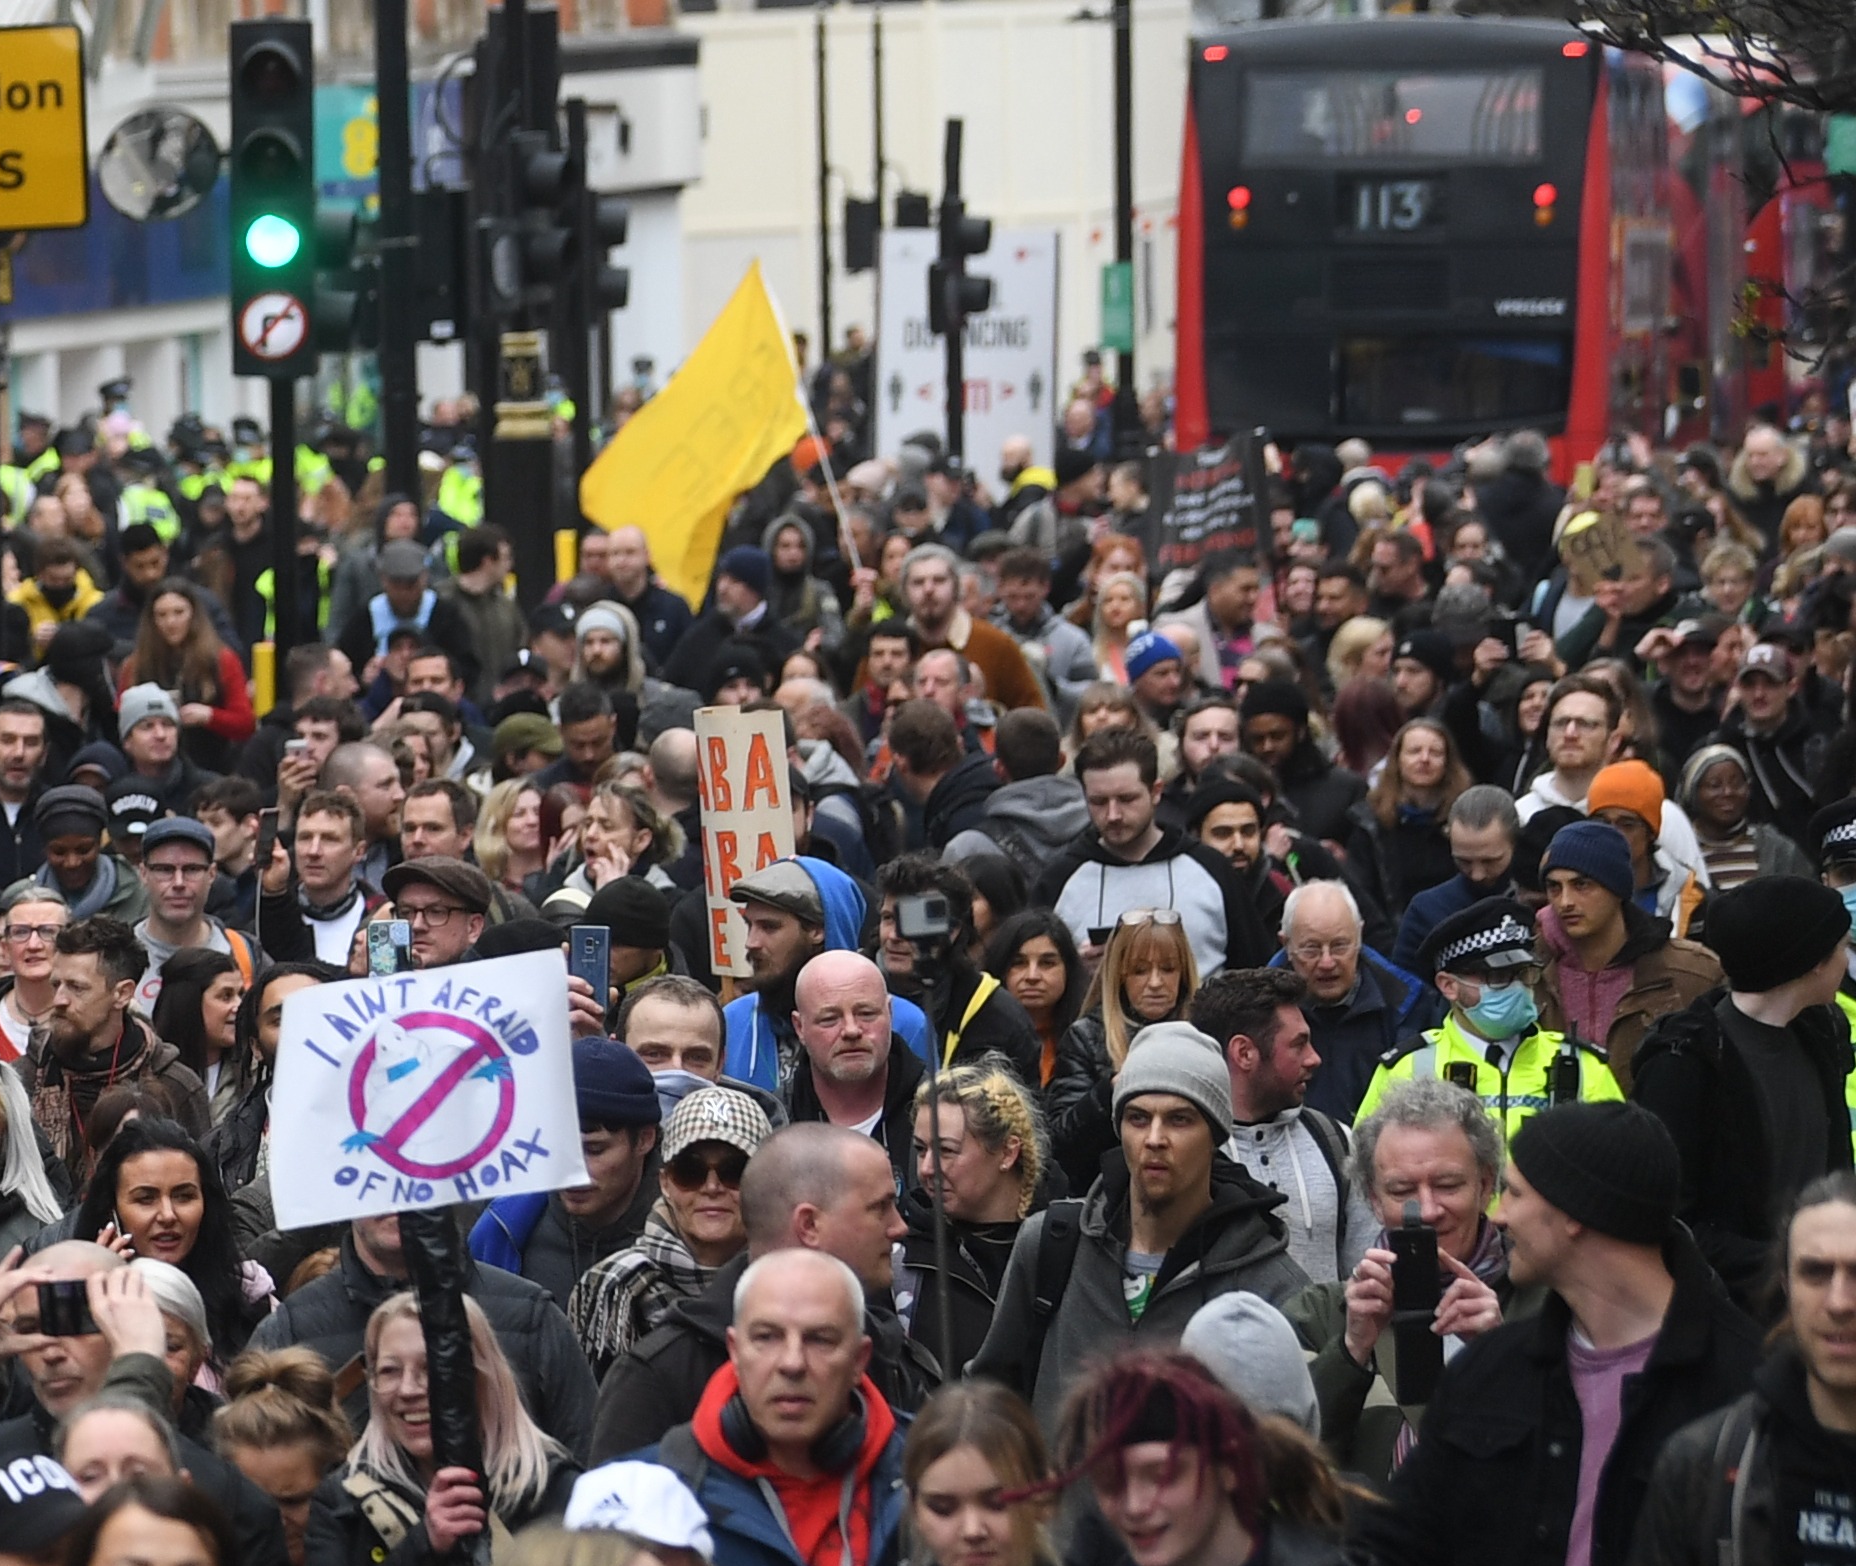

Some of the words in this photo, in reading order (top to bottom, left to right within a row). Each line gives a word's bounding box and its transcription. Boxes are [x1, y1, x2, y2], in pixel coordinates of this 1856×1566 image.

[1356, 181, 1425, 231] 113
[303, 1038, 341, 1069] I
[431, 978, 541, 1056] AFRAID
[334, 1165, 387, 1201] OF
[392, 1179, 434, 1204] NO
[453, 1127, 551, 1201] HOAX
